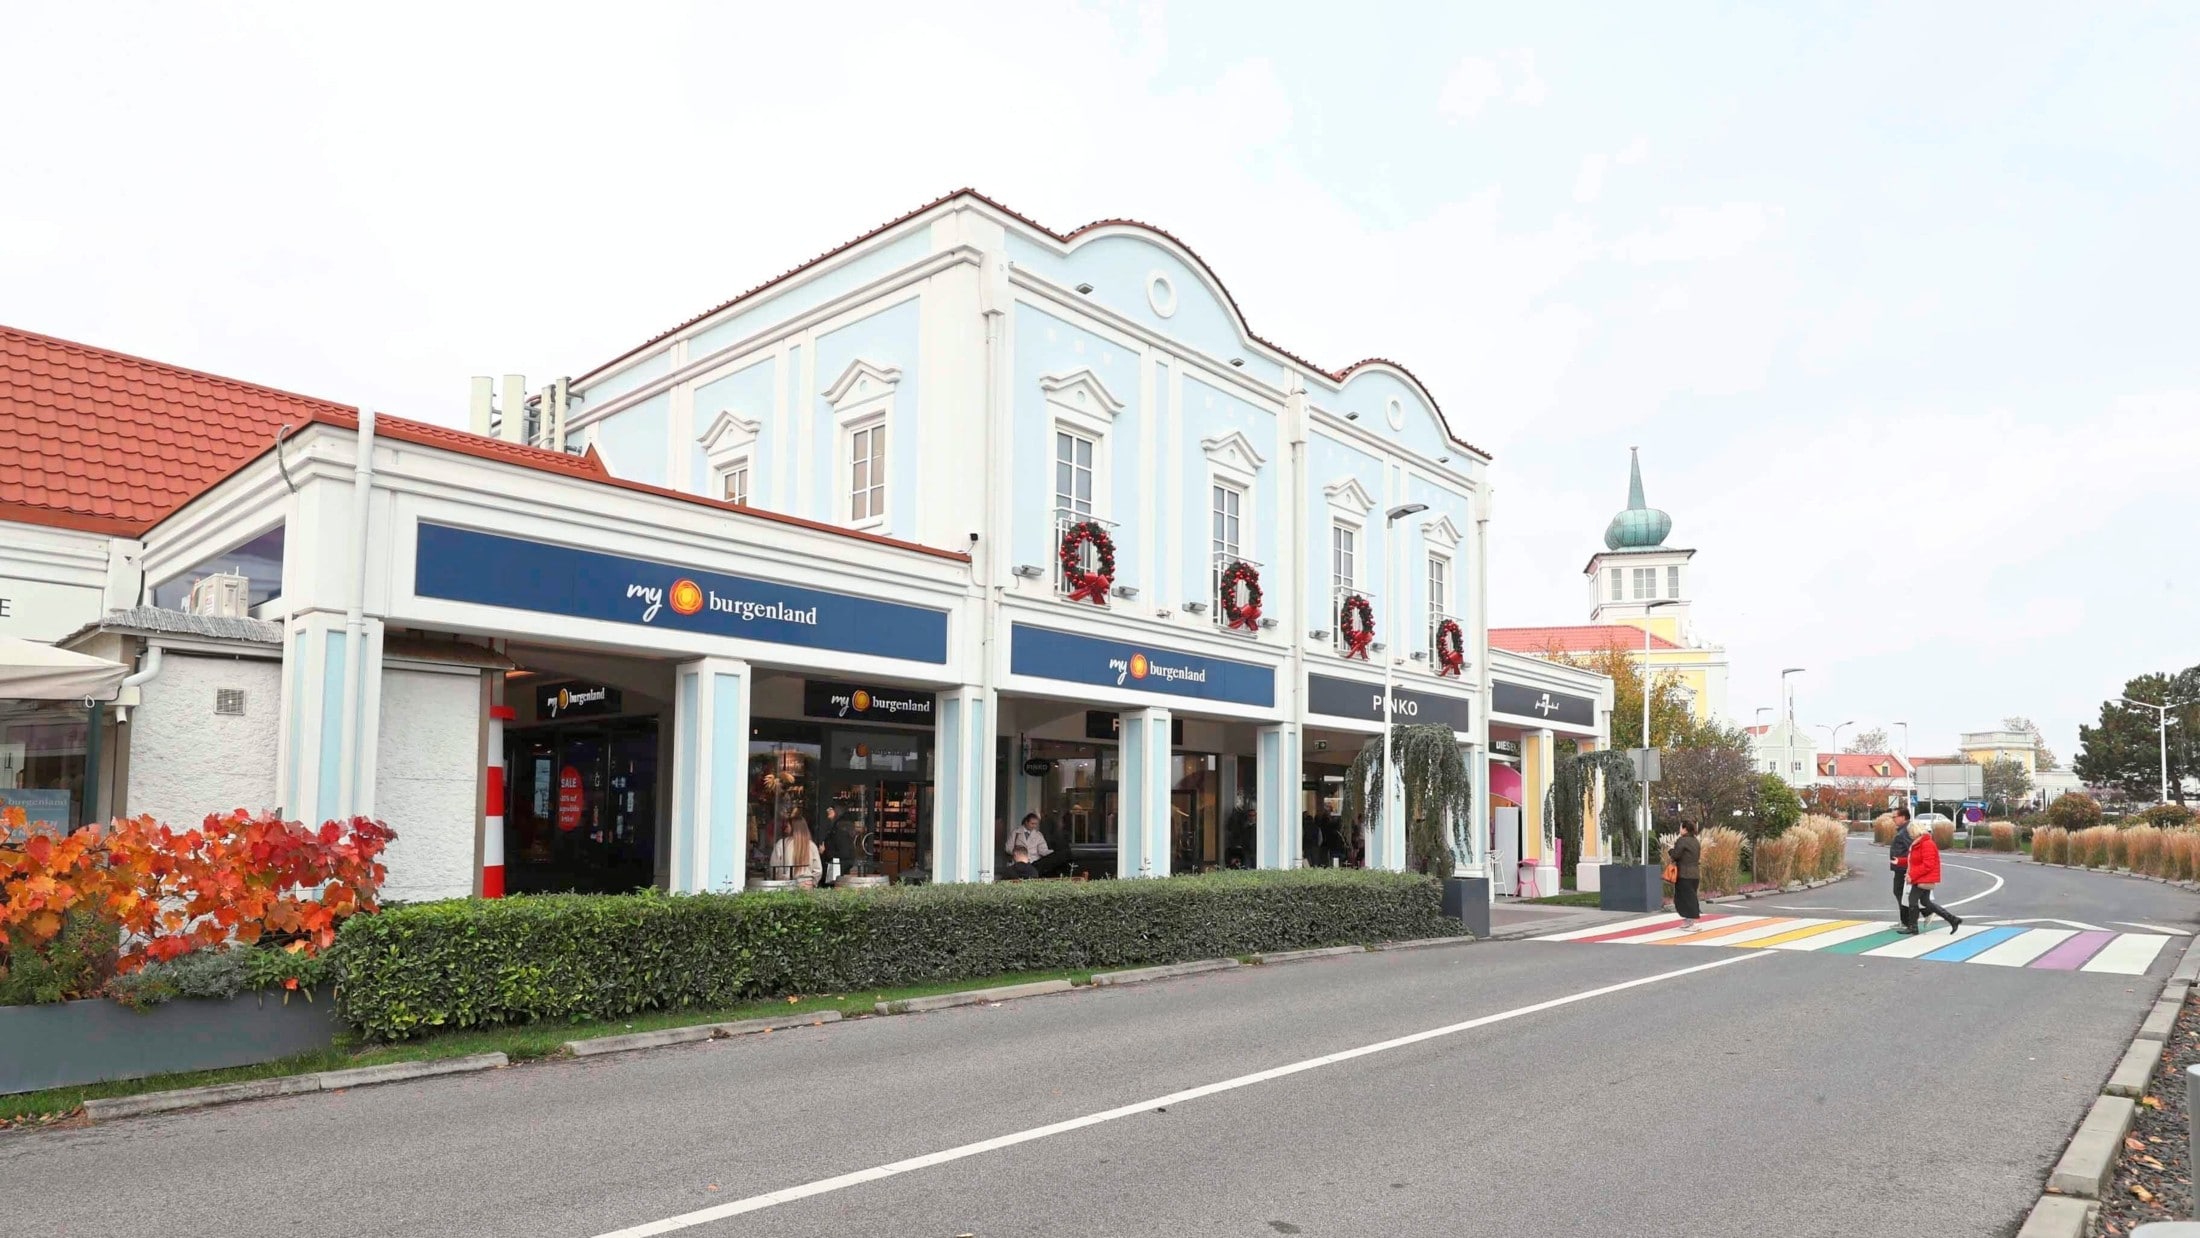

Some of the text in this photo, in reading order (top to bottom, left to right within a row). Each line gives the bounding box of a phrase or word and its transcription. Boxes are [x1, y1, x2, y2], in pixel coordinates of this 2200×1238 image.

[626, 583, 818, 625] my burgenland
[1109, 658, 1206, 685] my burgenland
[569, 686, 605, 706] burgenland
[830, 695, 930, 717] my burgenland
[561, 778, 577, 788] SALE
